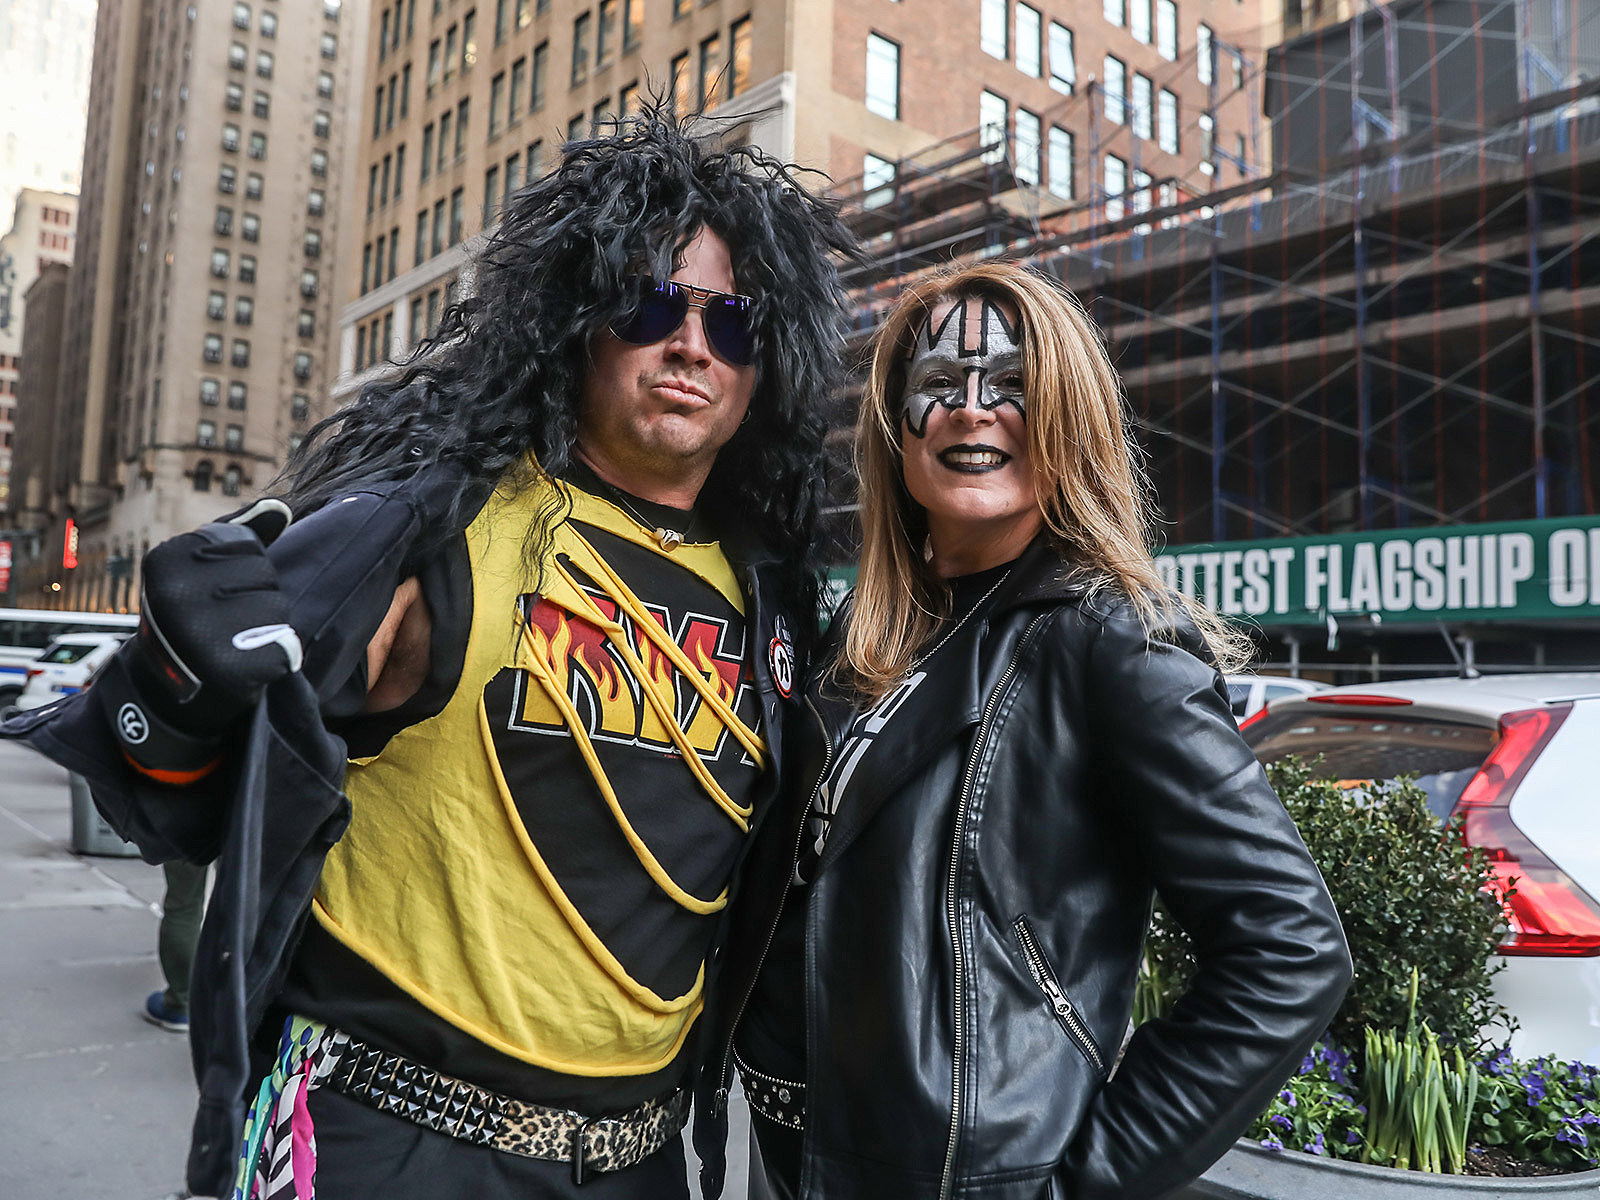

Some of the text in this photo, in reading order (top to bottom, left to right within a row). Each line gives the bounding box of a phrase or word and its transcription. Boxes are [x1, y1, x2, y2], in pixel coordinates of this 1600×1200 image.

[1153, 547, 1295, 615] OTTEST
[1304, 532, 1535, 611] FLAGSHIP
[507, 584, 763, 768] KIS
